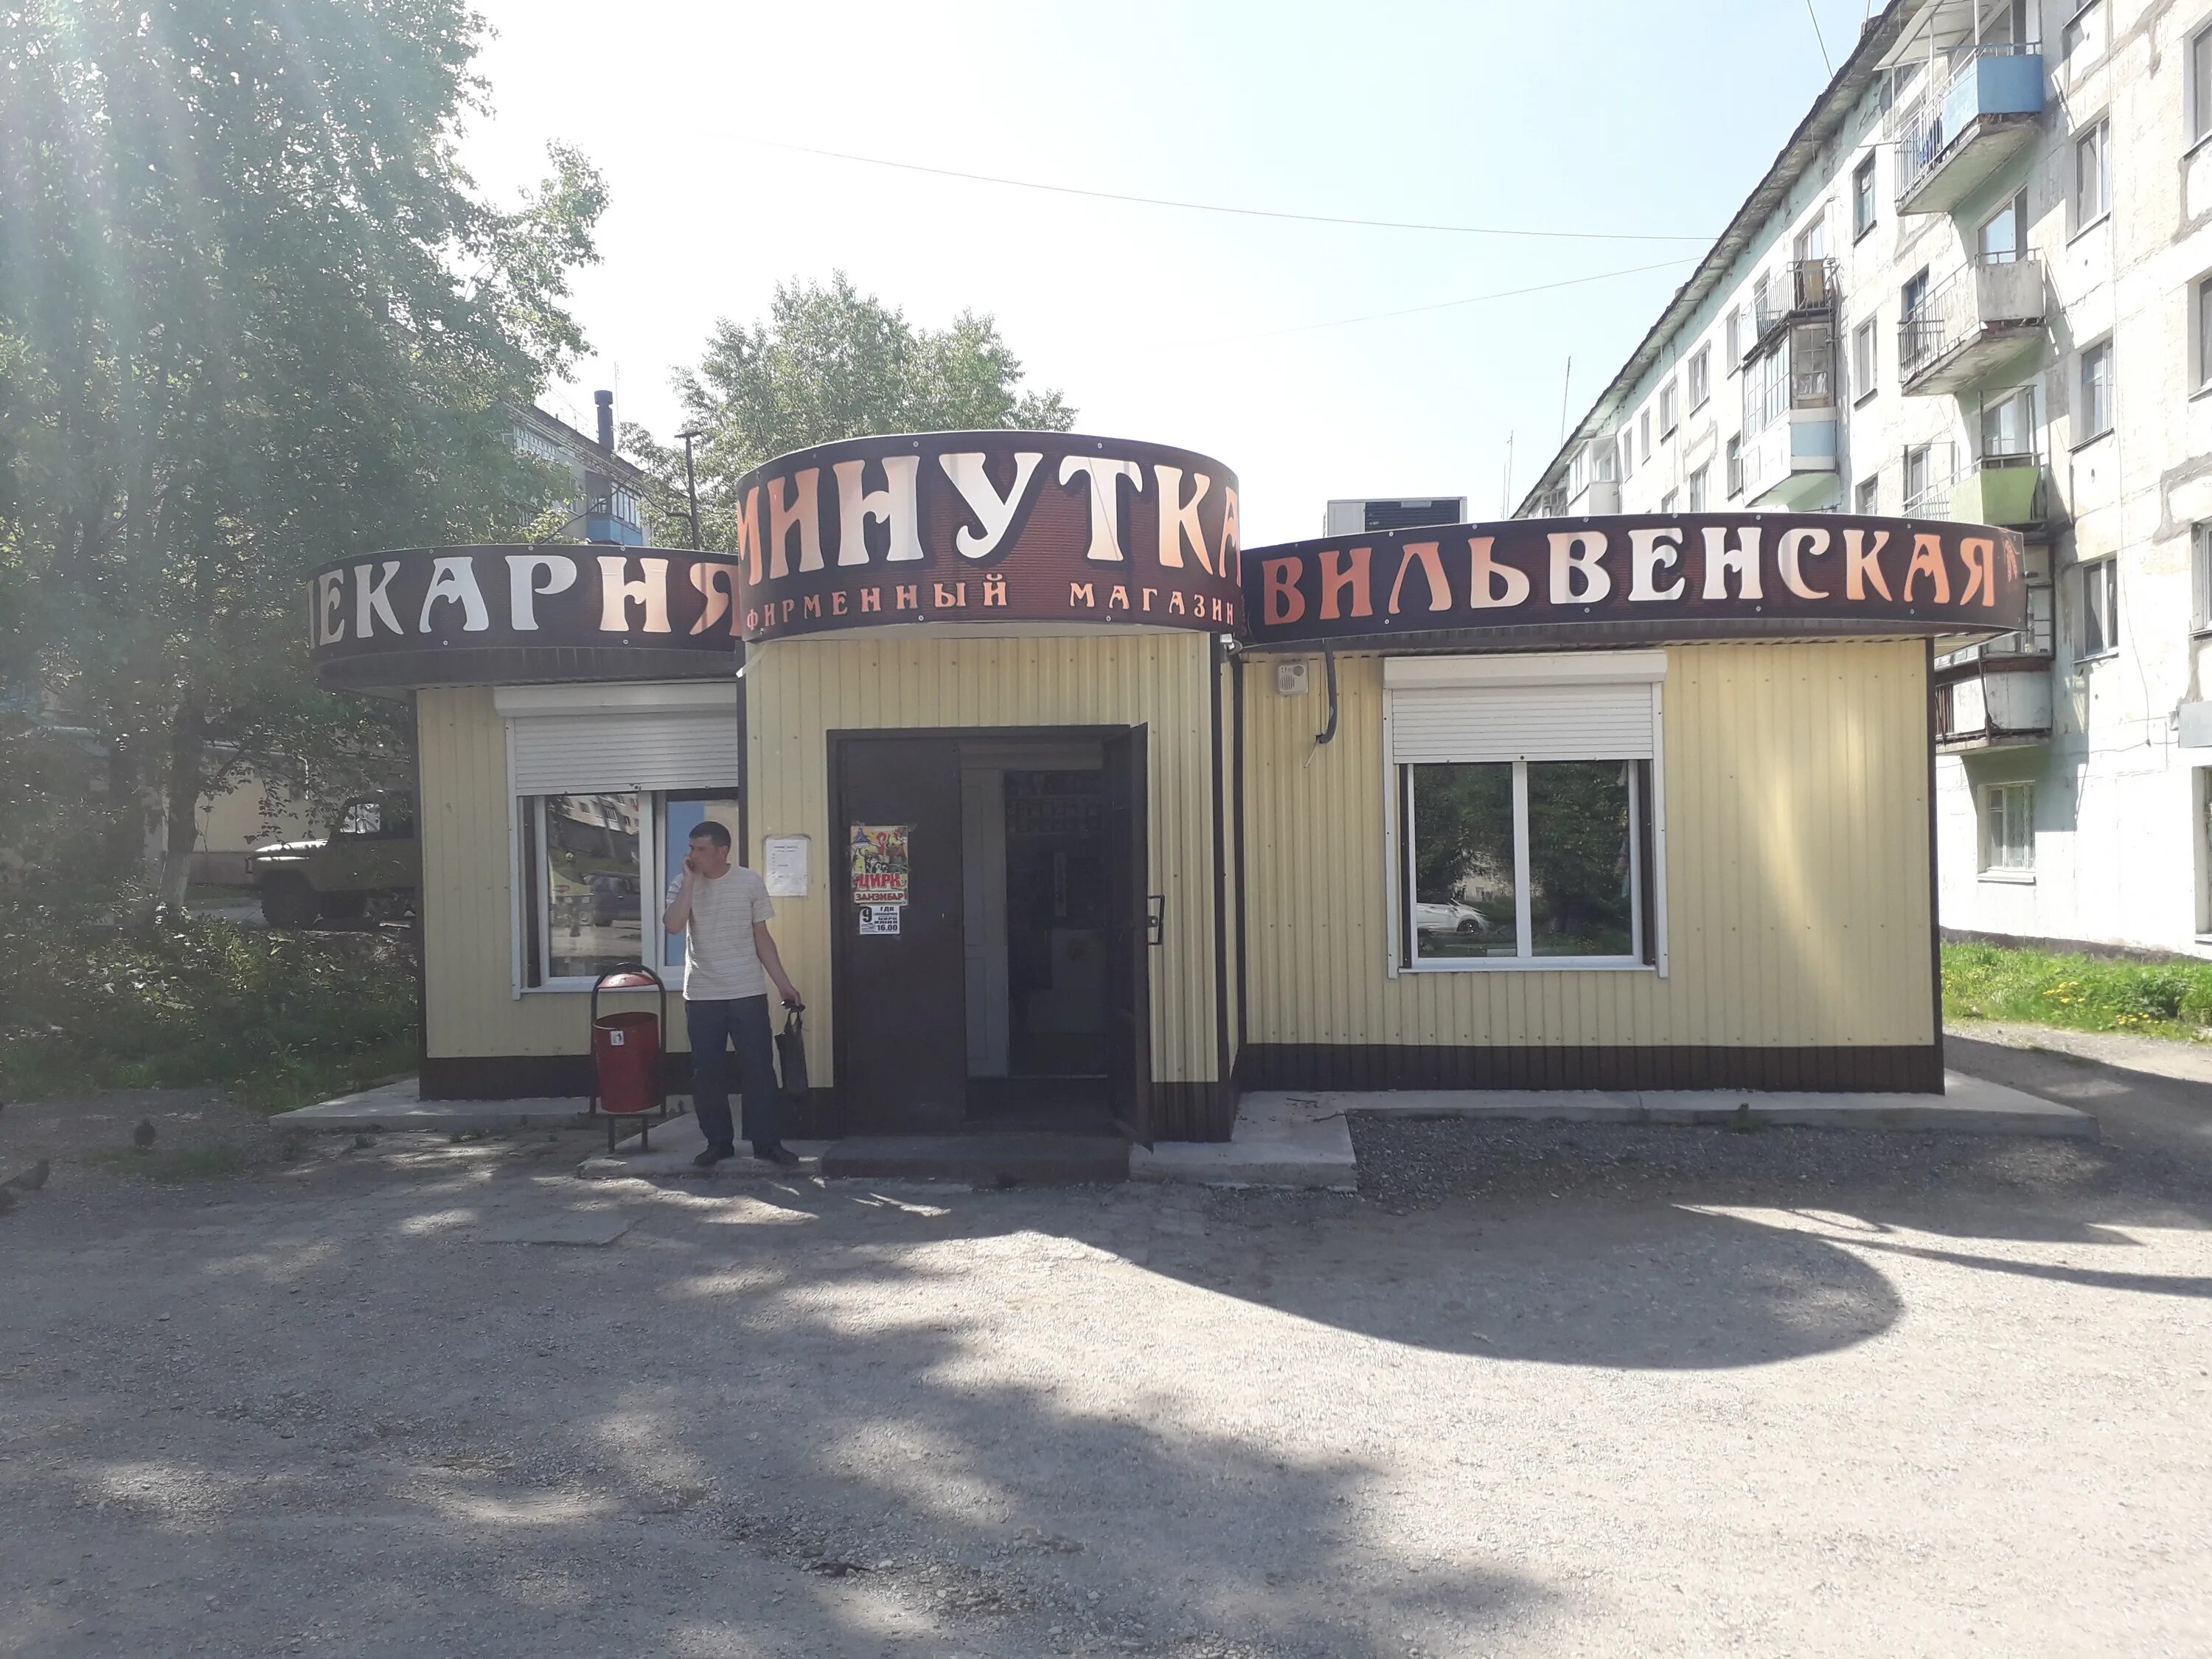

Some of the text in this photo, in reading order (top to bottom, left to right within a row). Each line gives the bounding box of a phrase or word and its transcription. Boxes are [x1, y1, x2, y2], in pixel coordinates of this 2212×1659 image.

[1262, 526, 1994, 626] ВИЛЬВЕНСКАЯ
[747, 574, 1234, 630] ФИРМЕННЫЙ МАГАЗИН
[858, 873, 901, 888] ЦИРК
[855, 893, 904, 901] ЗАНЗИБАР
[863, 907, 872, 922] 9
